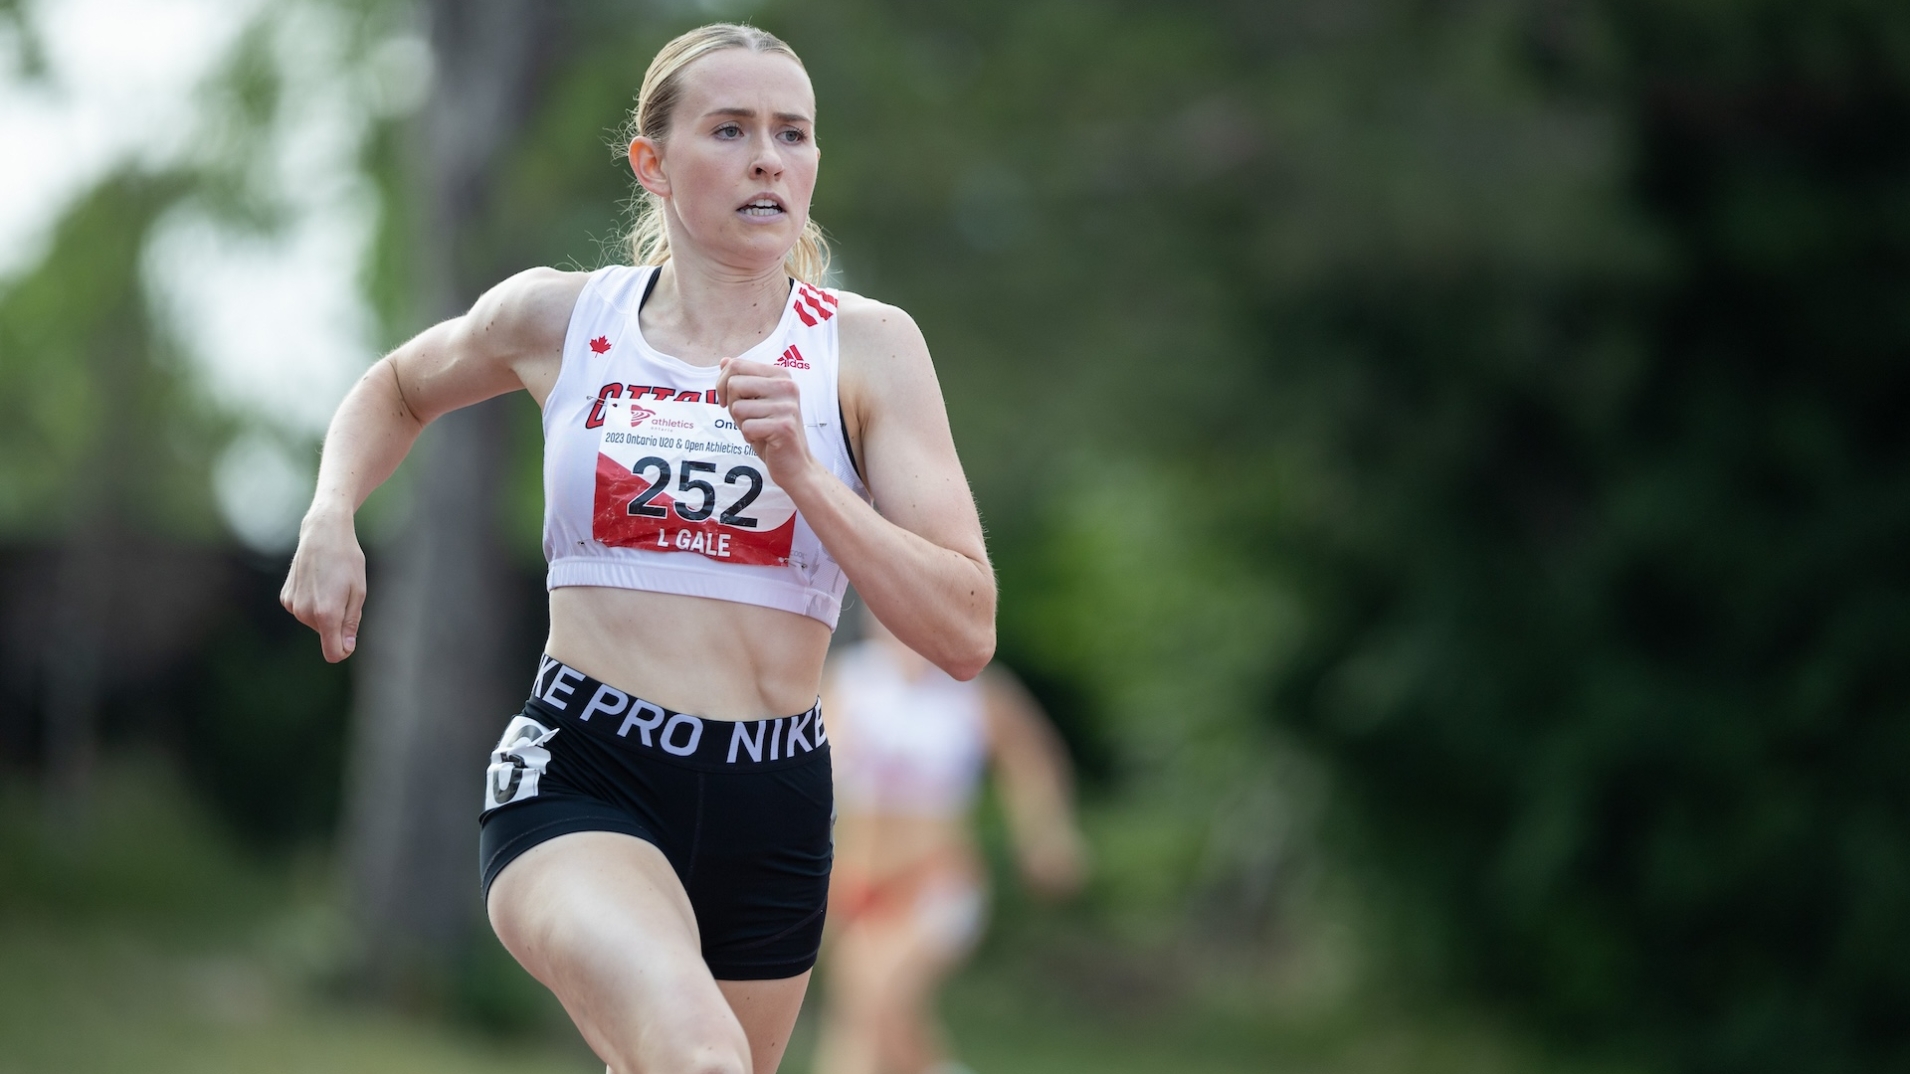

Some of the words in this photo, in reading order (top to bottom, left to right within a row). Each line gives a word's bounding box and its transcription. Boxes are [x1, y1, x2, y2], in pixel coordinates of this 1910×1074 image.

[774, 360, 811, 370] didas
[651, 418, 694, 429] athletics
[605, 432, 625, 444] 2023
[626, 433, 657, 447] Ontario
[659, 437, 674, 448] U20
[676, 439, 683, 449] &
[685, 439, 704, 452] Open
[705, 442, 743, 455] Athletics
[628, 456, 763, 528] 252
[657, 529, 669, 547] L
[676, 529, 731, 557] GALE
[580, 684, 703, 755] PRO
[726, 697, 827, 763] NIKE
